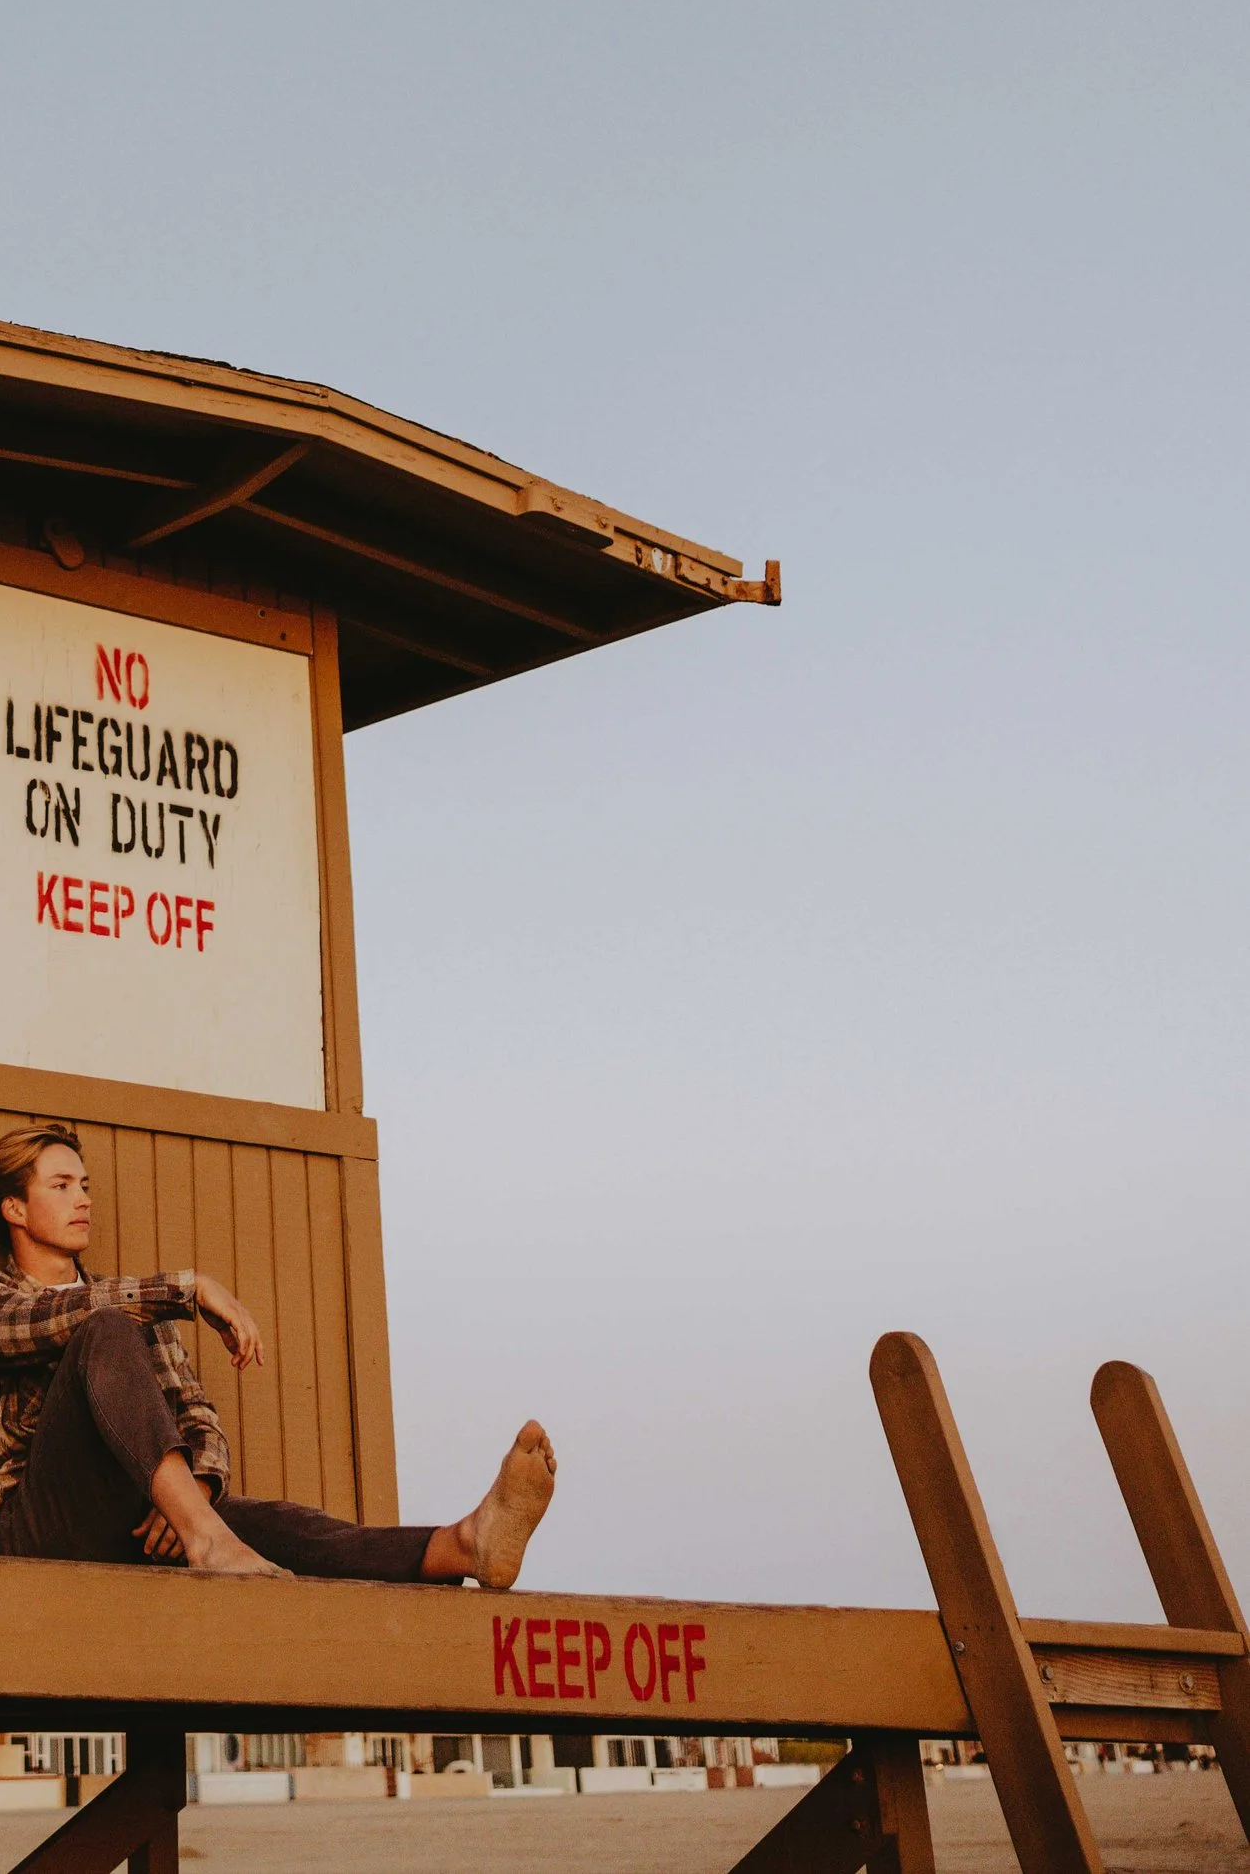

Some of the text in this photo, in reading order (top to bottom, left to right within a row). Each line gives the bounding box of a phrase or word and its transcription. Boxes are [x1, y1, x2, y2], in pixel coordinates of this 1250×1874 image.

[95, 642, 150, 710] NO
[5, 697, 240, 799] LIFEGUARD
[25, 778, 221, 870] ON DUTY
[36, 871, 216, 953] KEEP OFF
[492, 1615, 707, 1703] KEEP OFF
